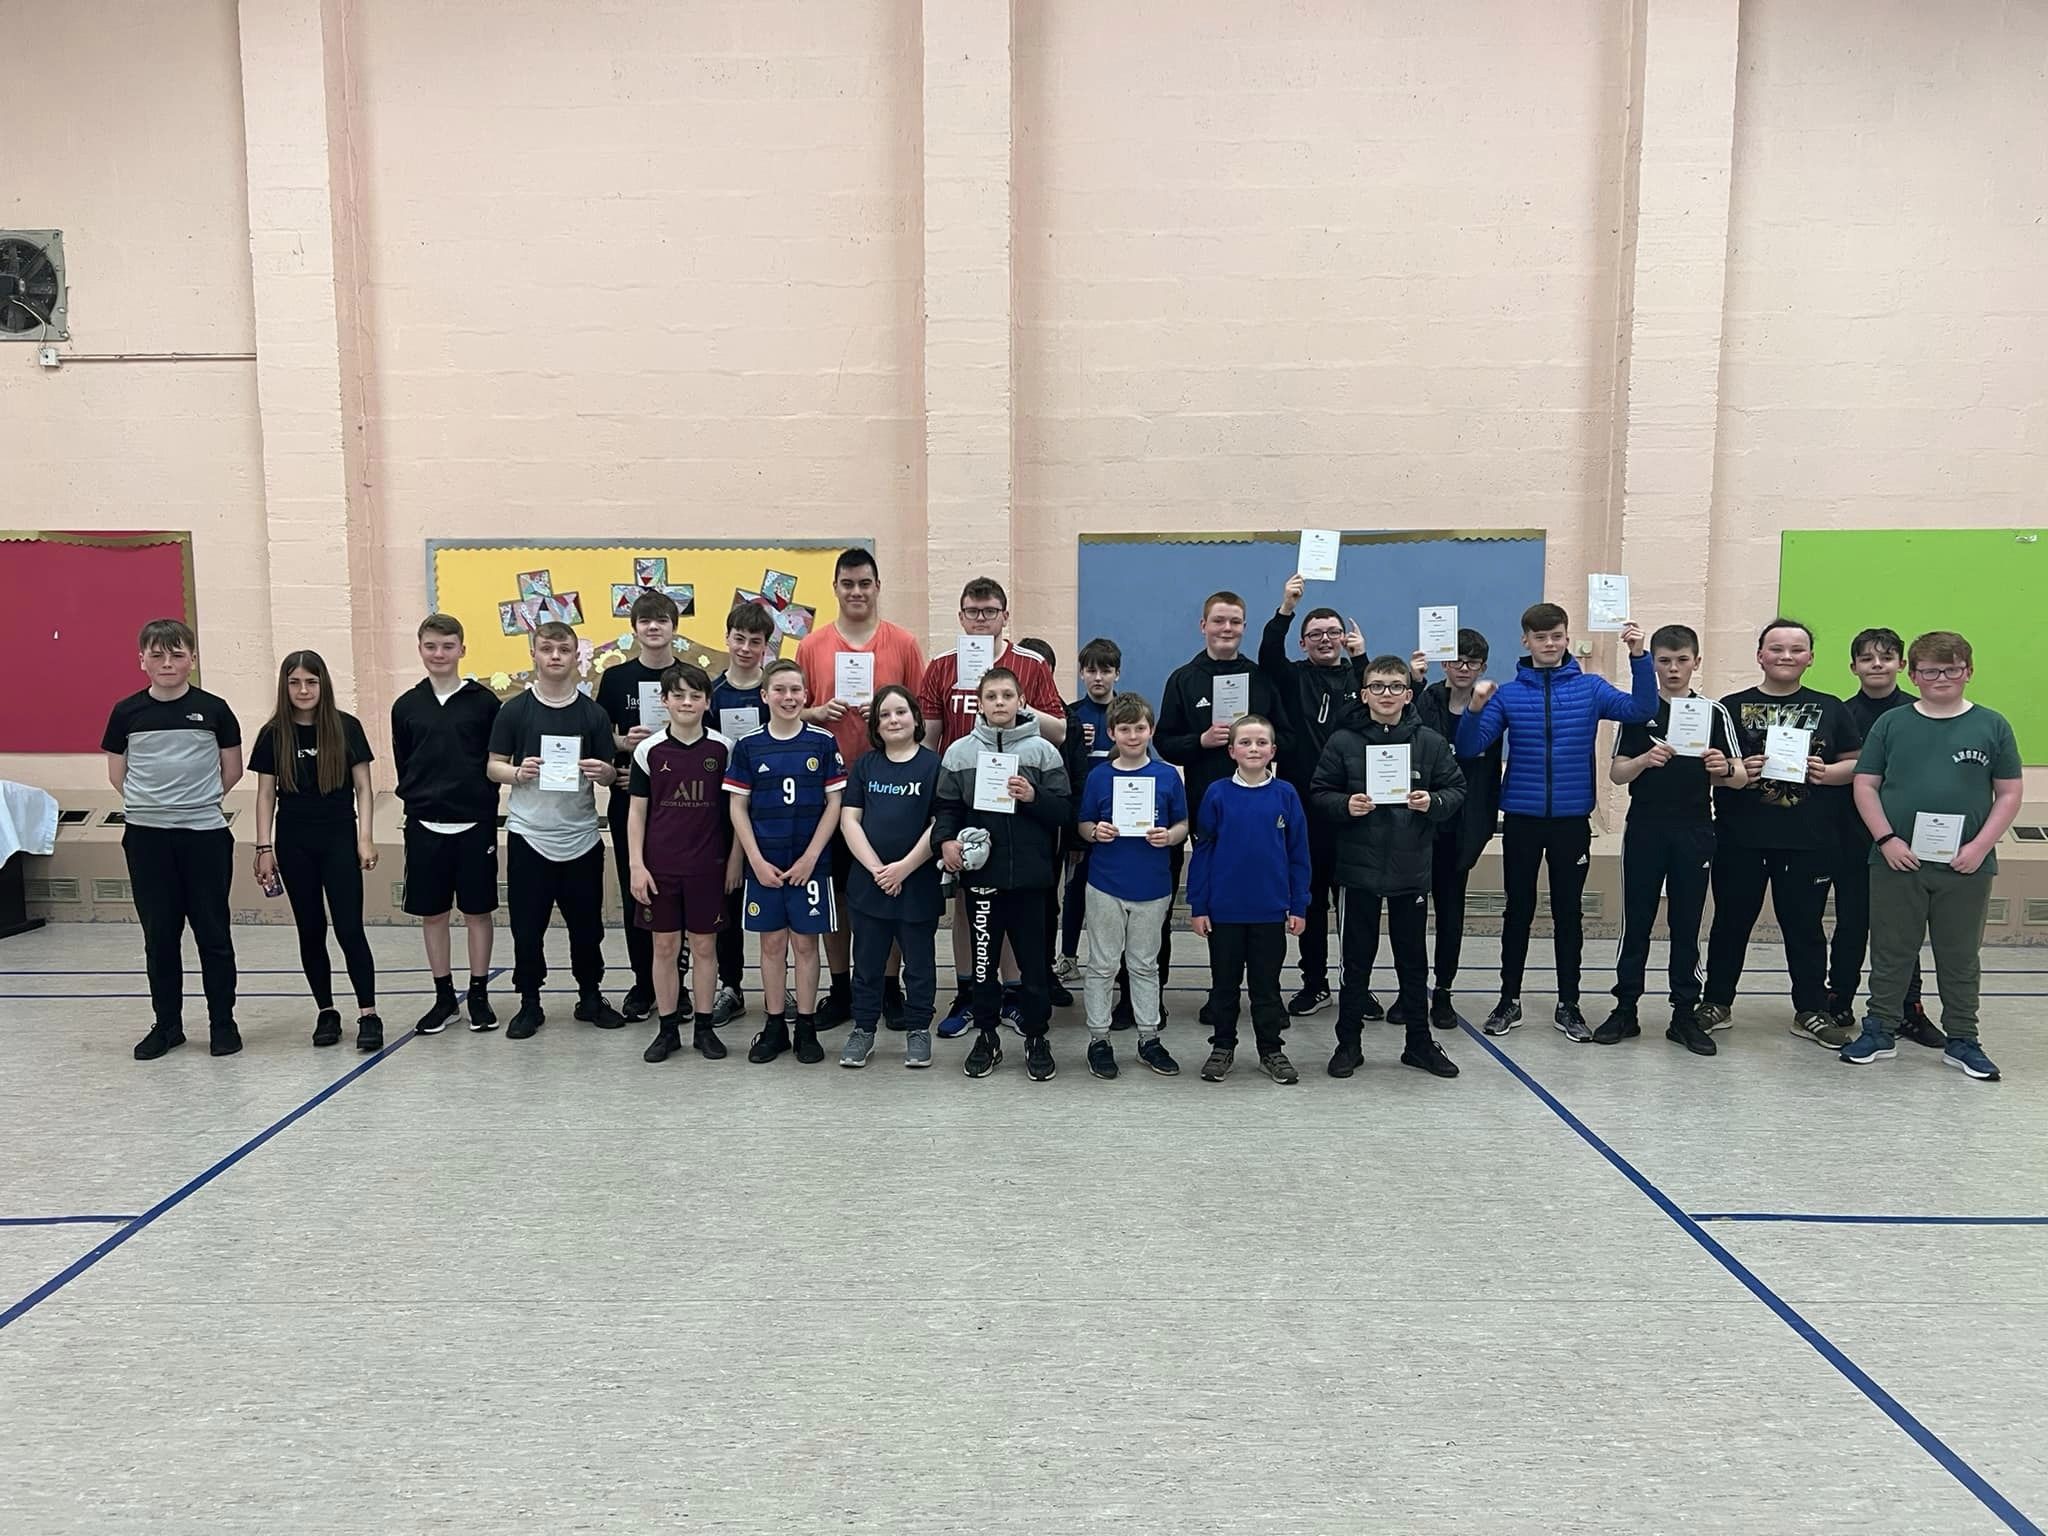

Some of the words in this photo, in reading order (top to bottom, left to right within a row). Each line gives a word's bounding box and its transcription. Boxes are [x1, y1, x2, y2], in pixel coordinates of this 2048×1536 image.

[782, 777, 796, 805] 9
[868, 780, 908, 796] Hurley
[806, 879, 820, 906] 9
[973, 900, 991, 983] PlayStation
